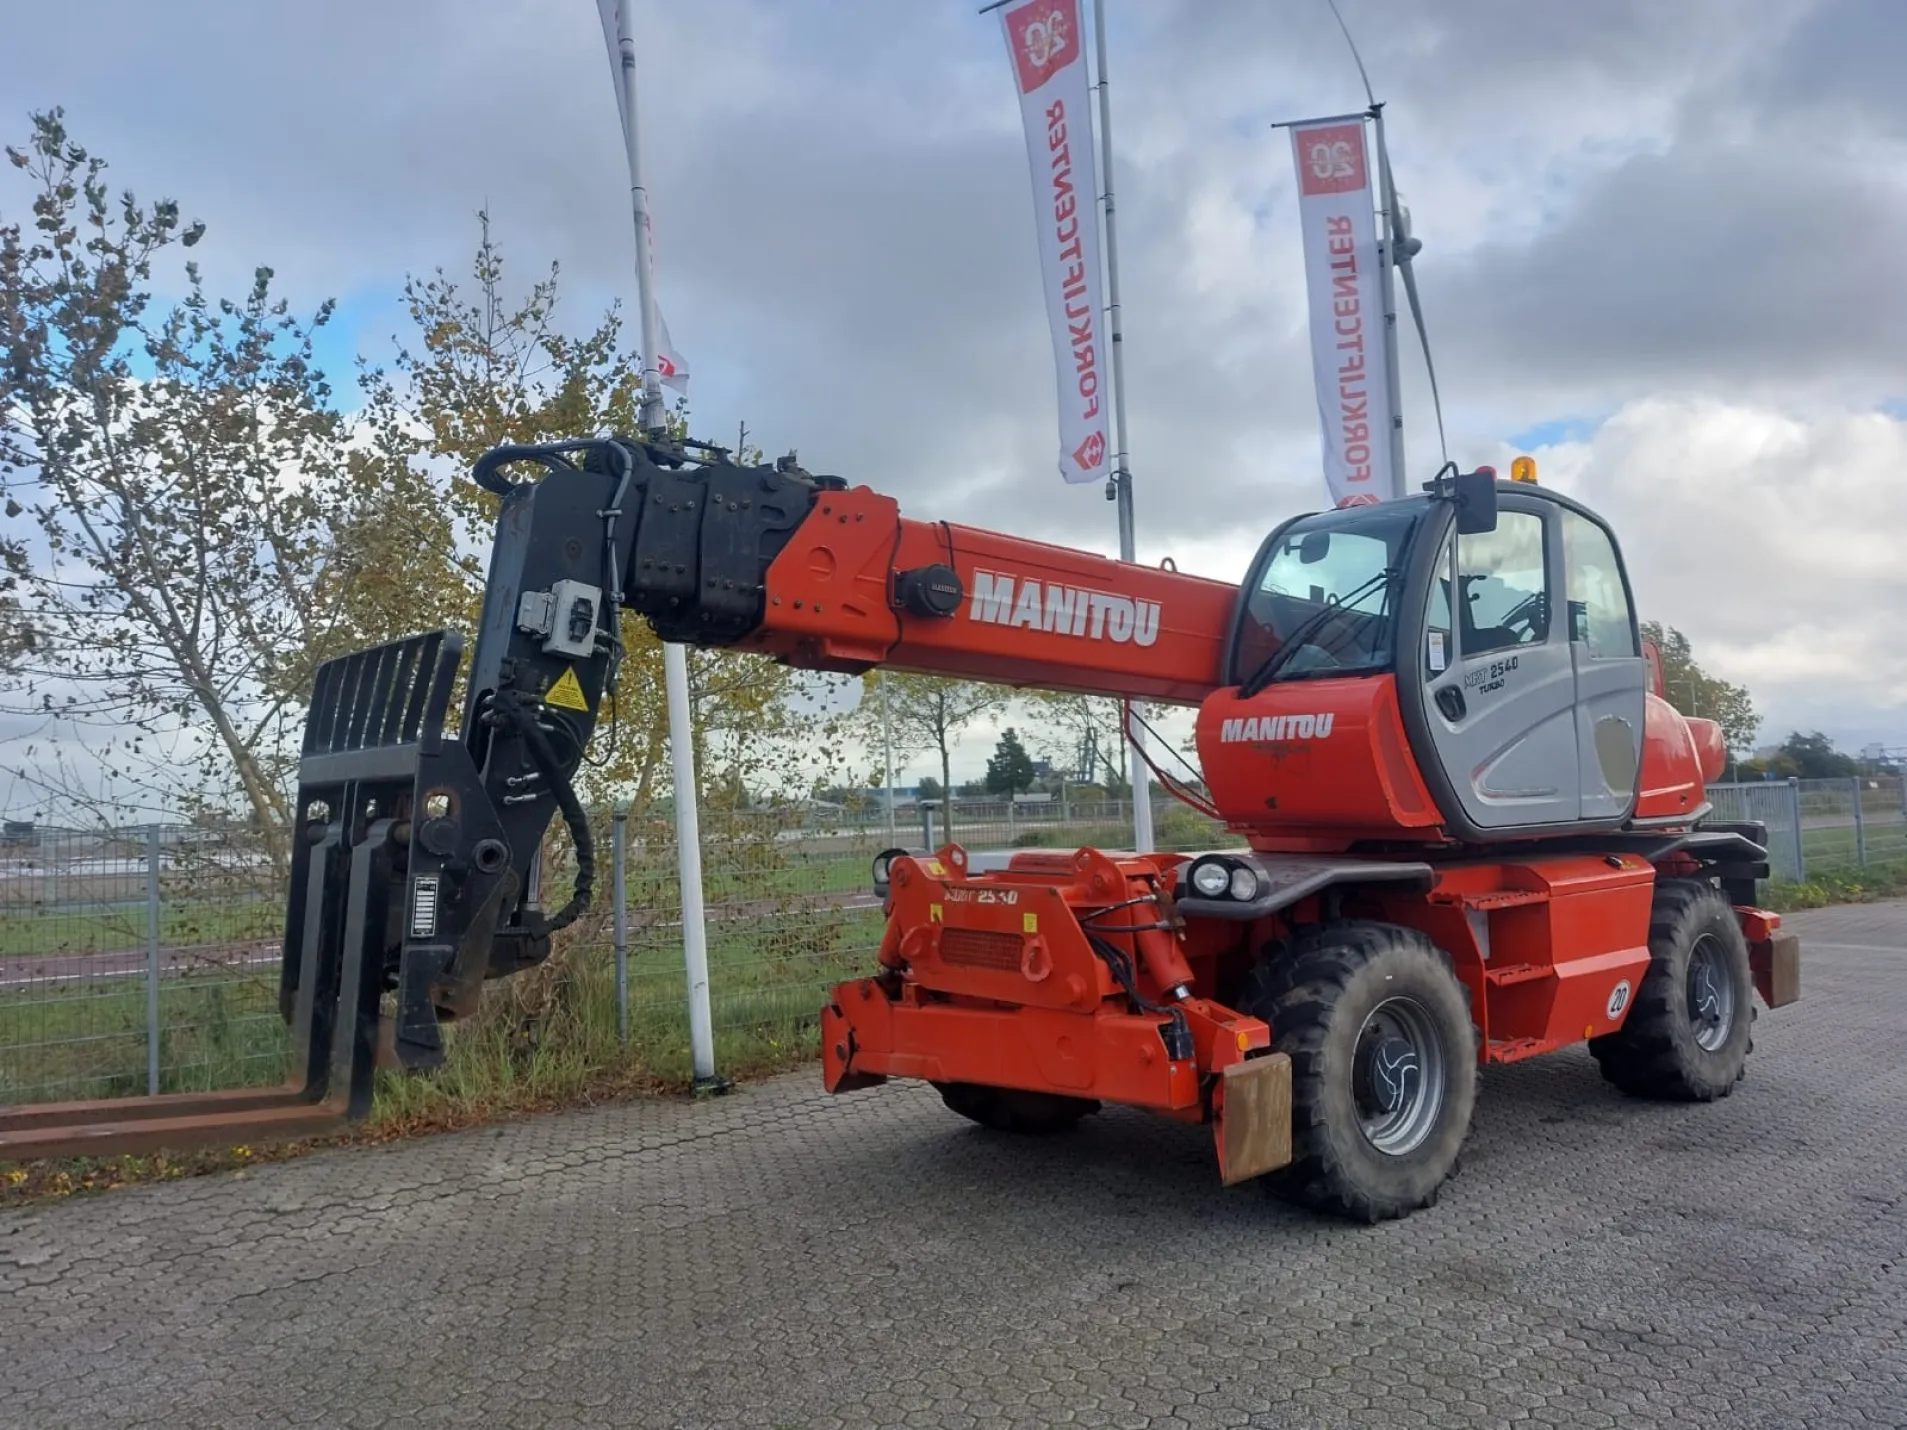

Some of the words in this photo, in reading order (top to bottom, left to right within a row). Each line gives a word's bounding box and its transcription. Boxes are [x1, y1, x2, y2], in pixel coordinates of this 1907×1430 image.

[969, 569, 1162, 647] MANITOU
[1490, 655, 1519, 679] 2540
[1478, 679, 1505, 696] TURBO
[1221, 713, 1335, 743] MANITOU
[1611, 987, 1628, 1013] 20
